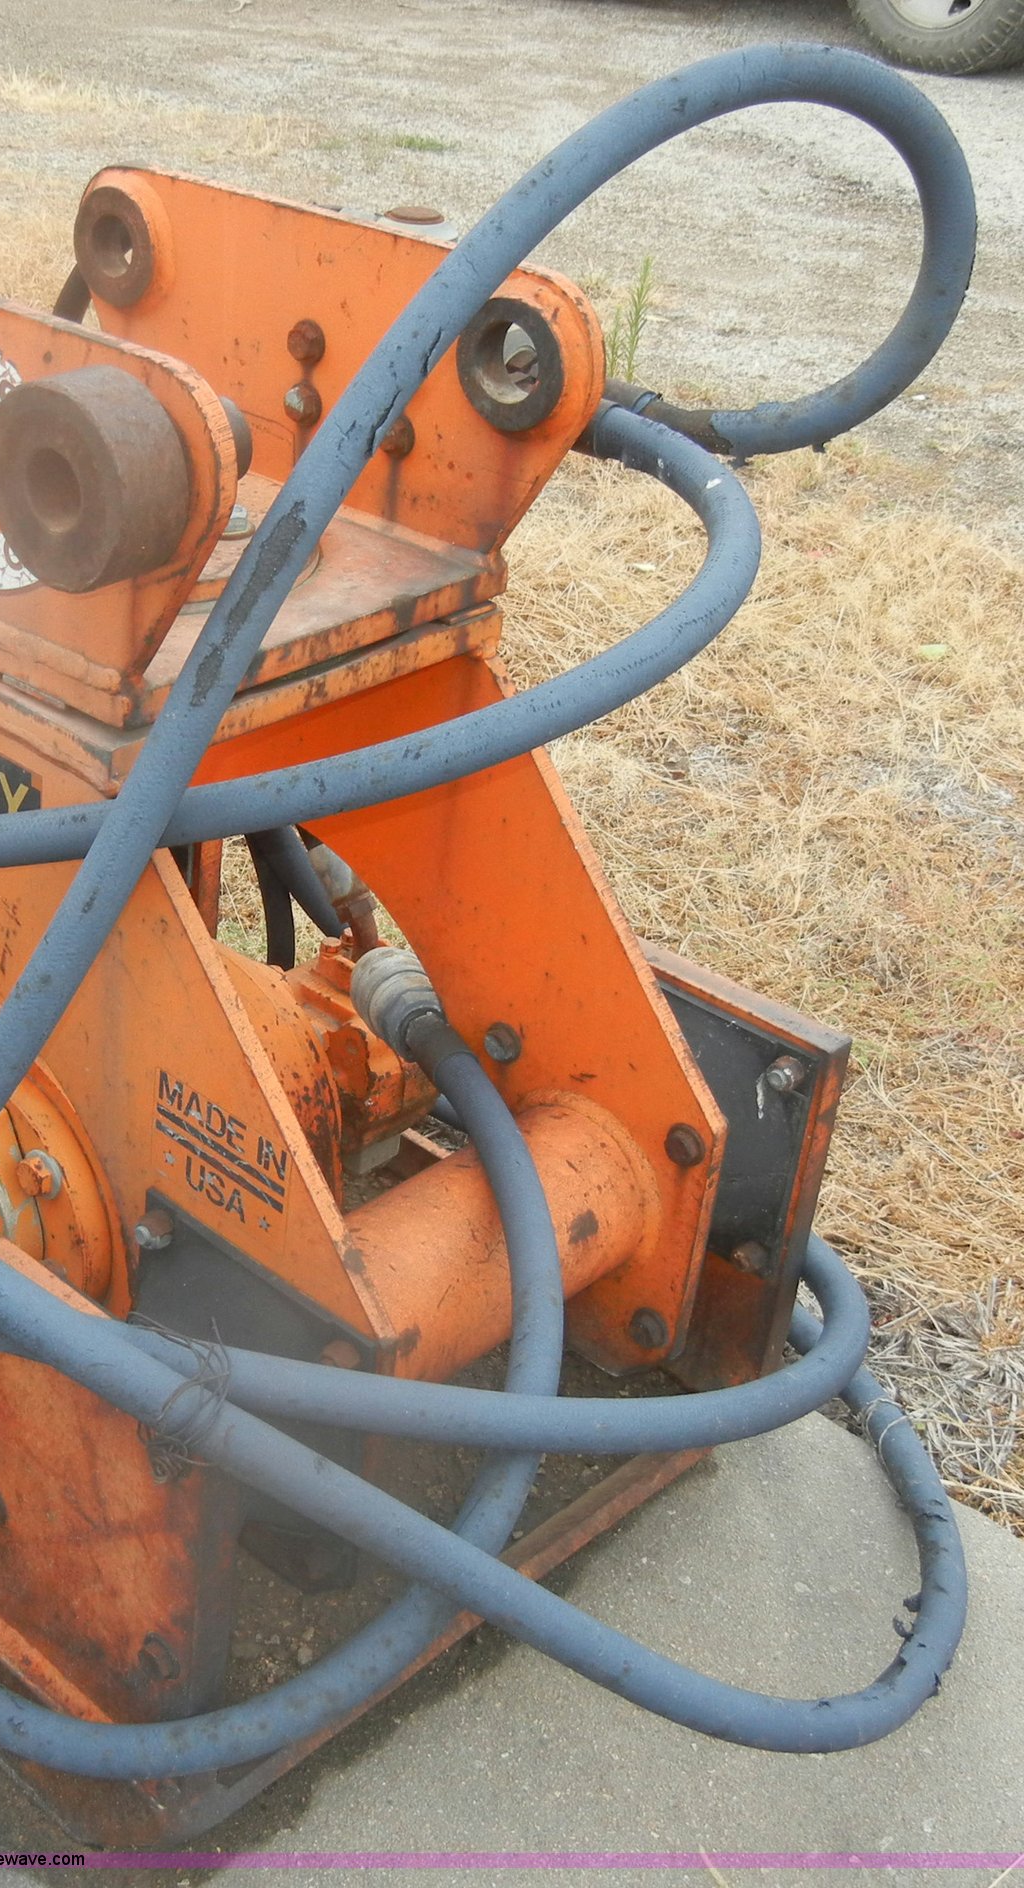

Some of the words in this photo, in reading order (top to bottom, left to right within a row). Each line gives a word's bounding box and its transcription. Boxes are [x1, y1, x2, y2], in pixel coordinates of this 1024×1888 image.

[158, 1070, 248, 1154] MADE
[257, 1136, 288, 1182] IN
[185, 1155, 246, 1224] USA
